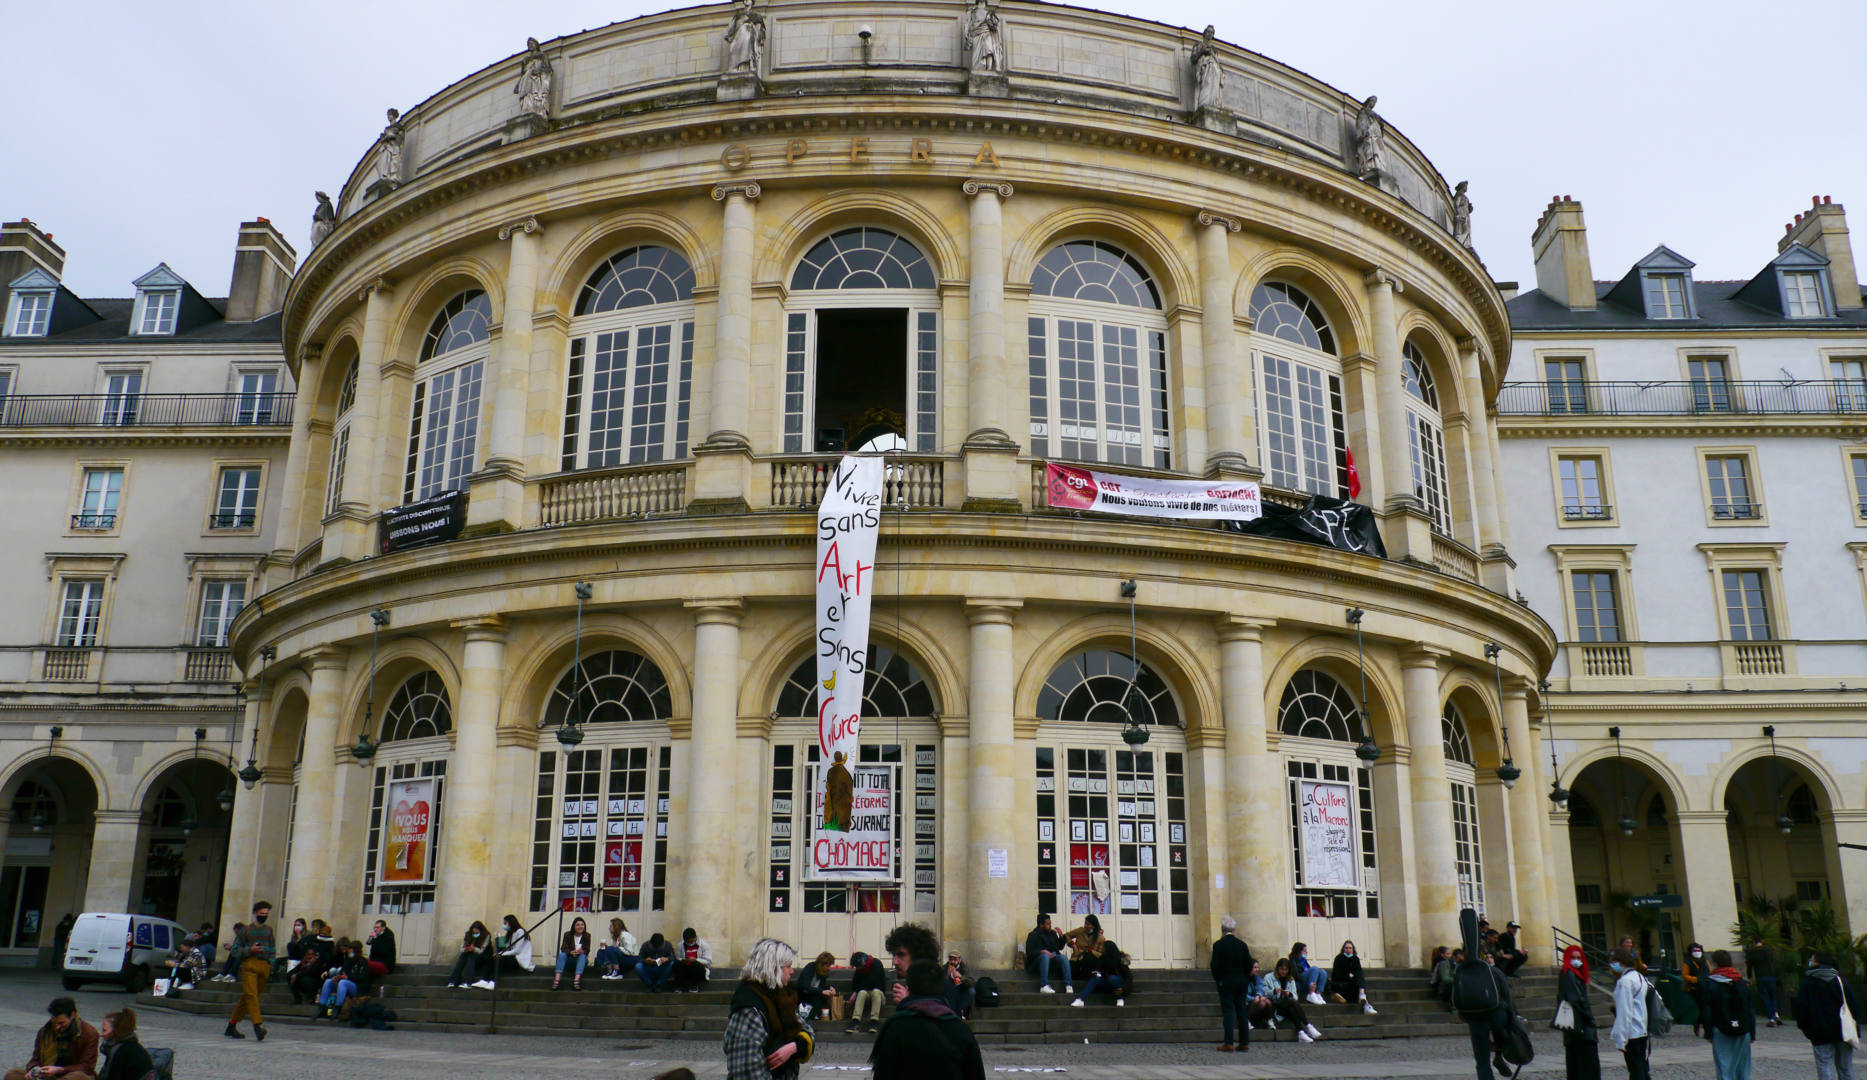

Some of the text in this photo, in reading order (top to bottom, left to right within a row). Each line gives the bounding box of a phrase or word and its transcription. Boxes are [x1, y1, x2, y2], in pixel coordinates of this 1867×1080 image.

[721, 137, 1000, 171] OPERA
[836, 464, 879, 506] Vivre
[1100, 481, 1121, 492] CGT
[1101, 493, 1126, 505] Nous
[1128, 498, 1165, 508] voulons
[1166, 501, 1189, 509] vivre
[1190, 501, 1201, 511] de
[1203, 502, 1219, 512] nos
[421, 518, 446, 532] NOUS
[1313, 784, 1346, 807] Culture
[566, 801, 669, 812] WE ARE
[1303, 811, 1310, 824] à
[1310, 808, 1319, 824] la
[568, 822, 639, 836] BACH
[1043, 824, 1182, 840] OCCUPÉ
[815, 838, 890, 868] CHÔMAGE
